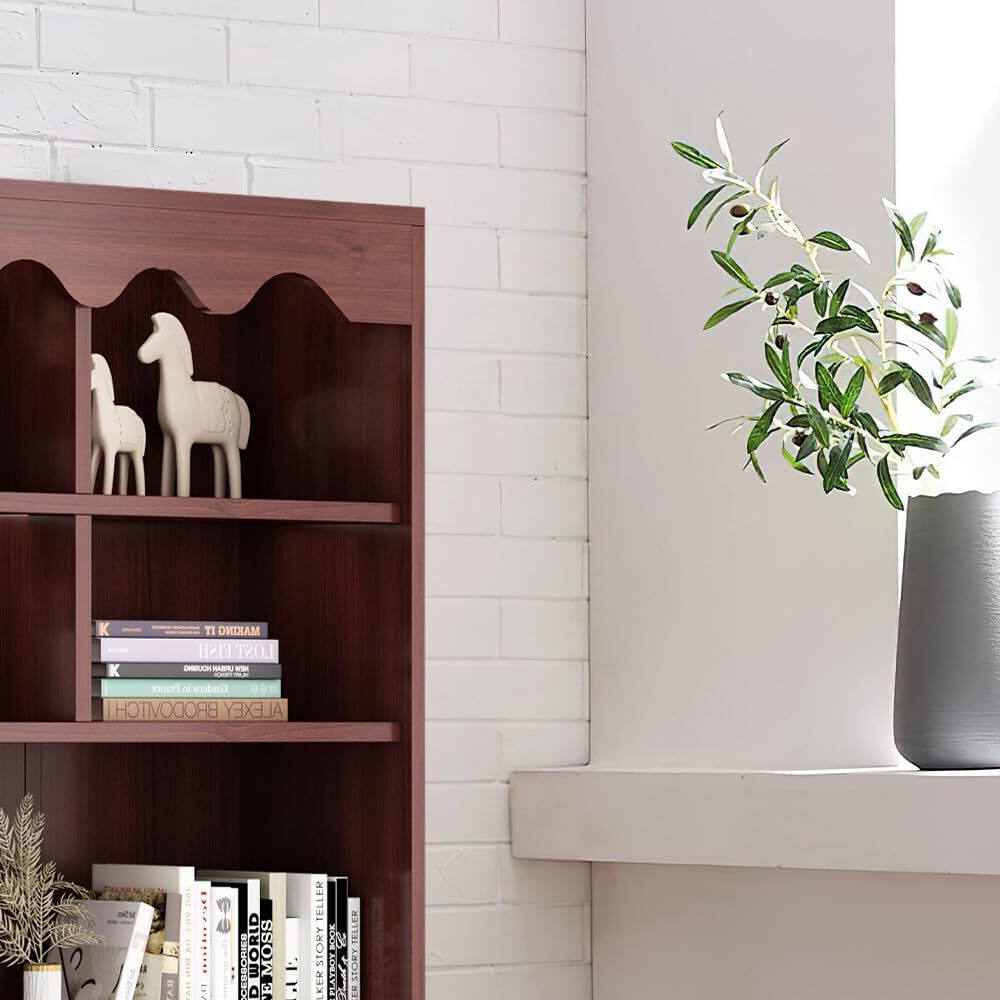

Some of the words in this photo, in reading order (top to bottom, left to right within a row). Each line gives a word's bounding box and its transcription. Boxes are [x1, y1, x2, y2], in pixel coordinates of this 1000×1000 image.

[315, 881, 324, 922] TELLER
[248, 912, 260, 978] WORLD
[261, 919, 273, 976] MOSS
[315, 926, 324, 966] STORY
[351, 910, 359, 945] TELLER
[351, 948, 359, 982] STORY
